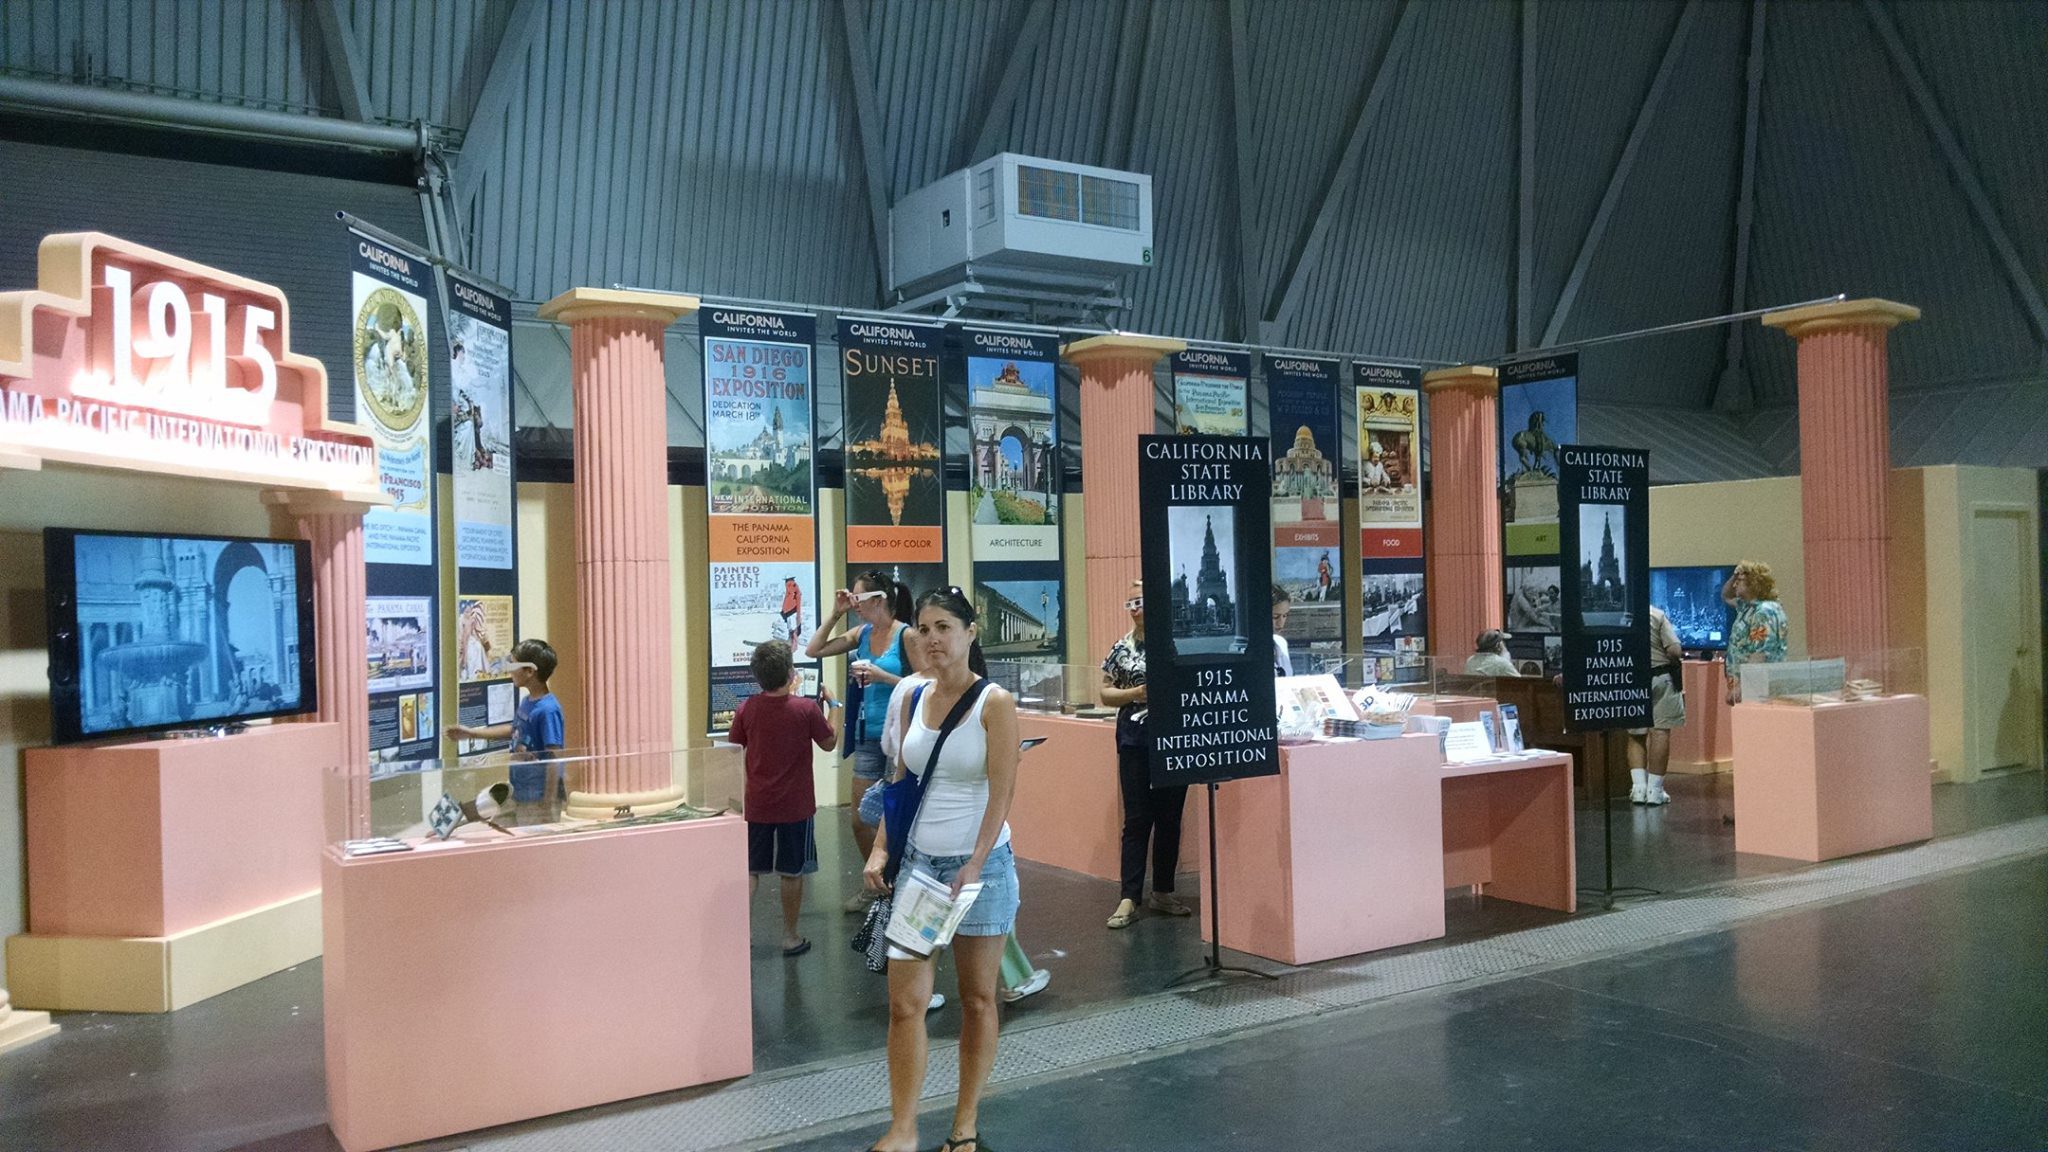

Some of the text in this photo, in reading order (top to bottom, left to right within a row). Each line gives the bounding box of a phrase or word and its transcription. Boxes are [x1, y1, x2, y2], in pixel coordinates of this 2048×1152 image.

[359, 242, 410, 275] CALIFORNIA
[1142, 250, 1151, 263] 6
[390, 270, 401, 279] THE
[401, 275, 418, 288] WORLD
[455, 283, 494, 310] CALIFORNIA
[713, 312, 785, 329] CALIFORNIA
[727, 326, 755, 334] INVITES
[850, 324, 915, 340] CALIFORNIA
[105, 265, 277, 426] 1915
[975, 334, 1033, 349] CALIFORNIA
[713, 344, 804, 368] SAN DIEGO
[846, 349, 936, 377] SUNSET
[1179, 352, 1228, 365] CALIFORNIA
[731, 365, 787, 380] 1916
[1274, 360, 1320, 372] CALIFORNIA
[1361, 367, 1403, 378] CALIFORNIA
[1507, 359, 1557, 375] CALIFORNIA
[712, 378, 805, 400] EXPOSITION
[712, 401, 761, 409] DEDICATION
[712, 410, 743, 418] MARCH
[145, 413, 282, 459] INTERNATIONAL
[289, 436, 374, 466] EXPOSITION
[1146, 442, 1262, 460] CALIFORNIA
[1565, 451, 1644, 468] CALIFORNIA
[1181, 464, 1231, 480] STATE
[1588, 469, 1623, 483] STATE
[383, 474, 421, 490] FRANCISCO
[734, 495, 808, 504] INTERNATIONAL
[1171, 484, 1243, 500] LIBRARY
[1581, 486, 1631, 500] LIBRARY
[732, 523, 792, 531] THE PANAMA-
[736, 535, 790, 544] CALIFORNIA
[856, 539, 931, 548] CHORD OF COLOR
[990, 539, 1042, 547] ARCHITECTURE
[1294, 533, 1319, 542] EXHIBITS
[1382, 539, 1401, 547] FOOD
[736, 547, 790, 555] EXPOSITION
[1597, 639, 1622, 653] 1915
[1586, 656, 1634, 669] PANAMA
[1196, 669, 1233, 686] 1915
[1587, 672, 1633, 686] PACIFIC
[1180, 689, 1249, 707] PANAMA
[1360, 695, 1375, 711] 3D
[1568, 688, 1650, 704] INTERNATIONAL
[1182, 709, 1248, 728] PACIFIC
[1575, 705, 1645, 721] EXPOSITION
[1157, 727, 1274, 750] INTERNATIONAL
[1166, 747, 1267, 771] EXPOSITION
